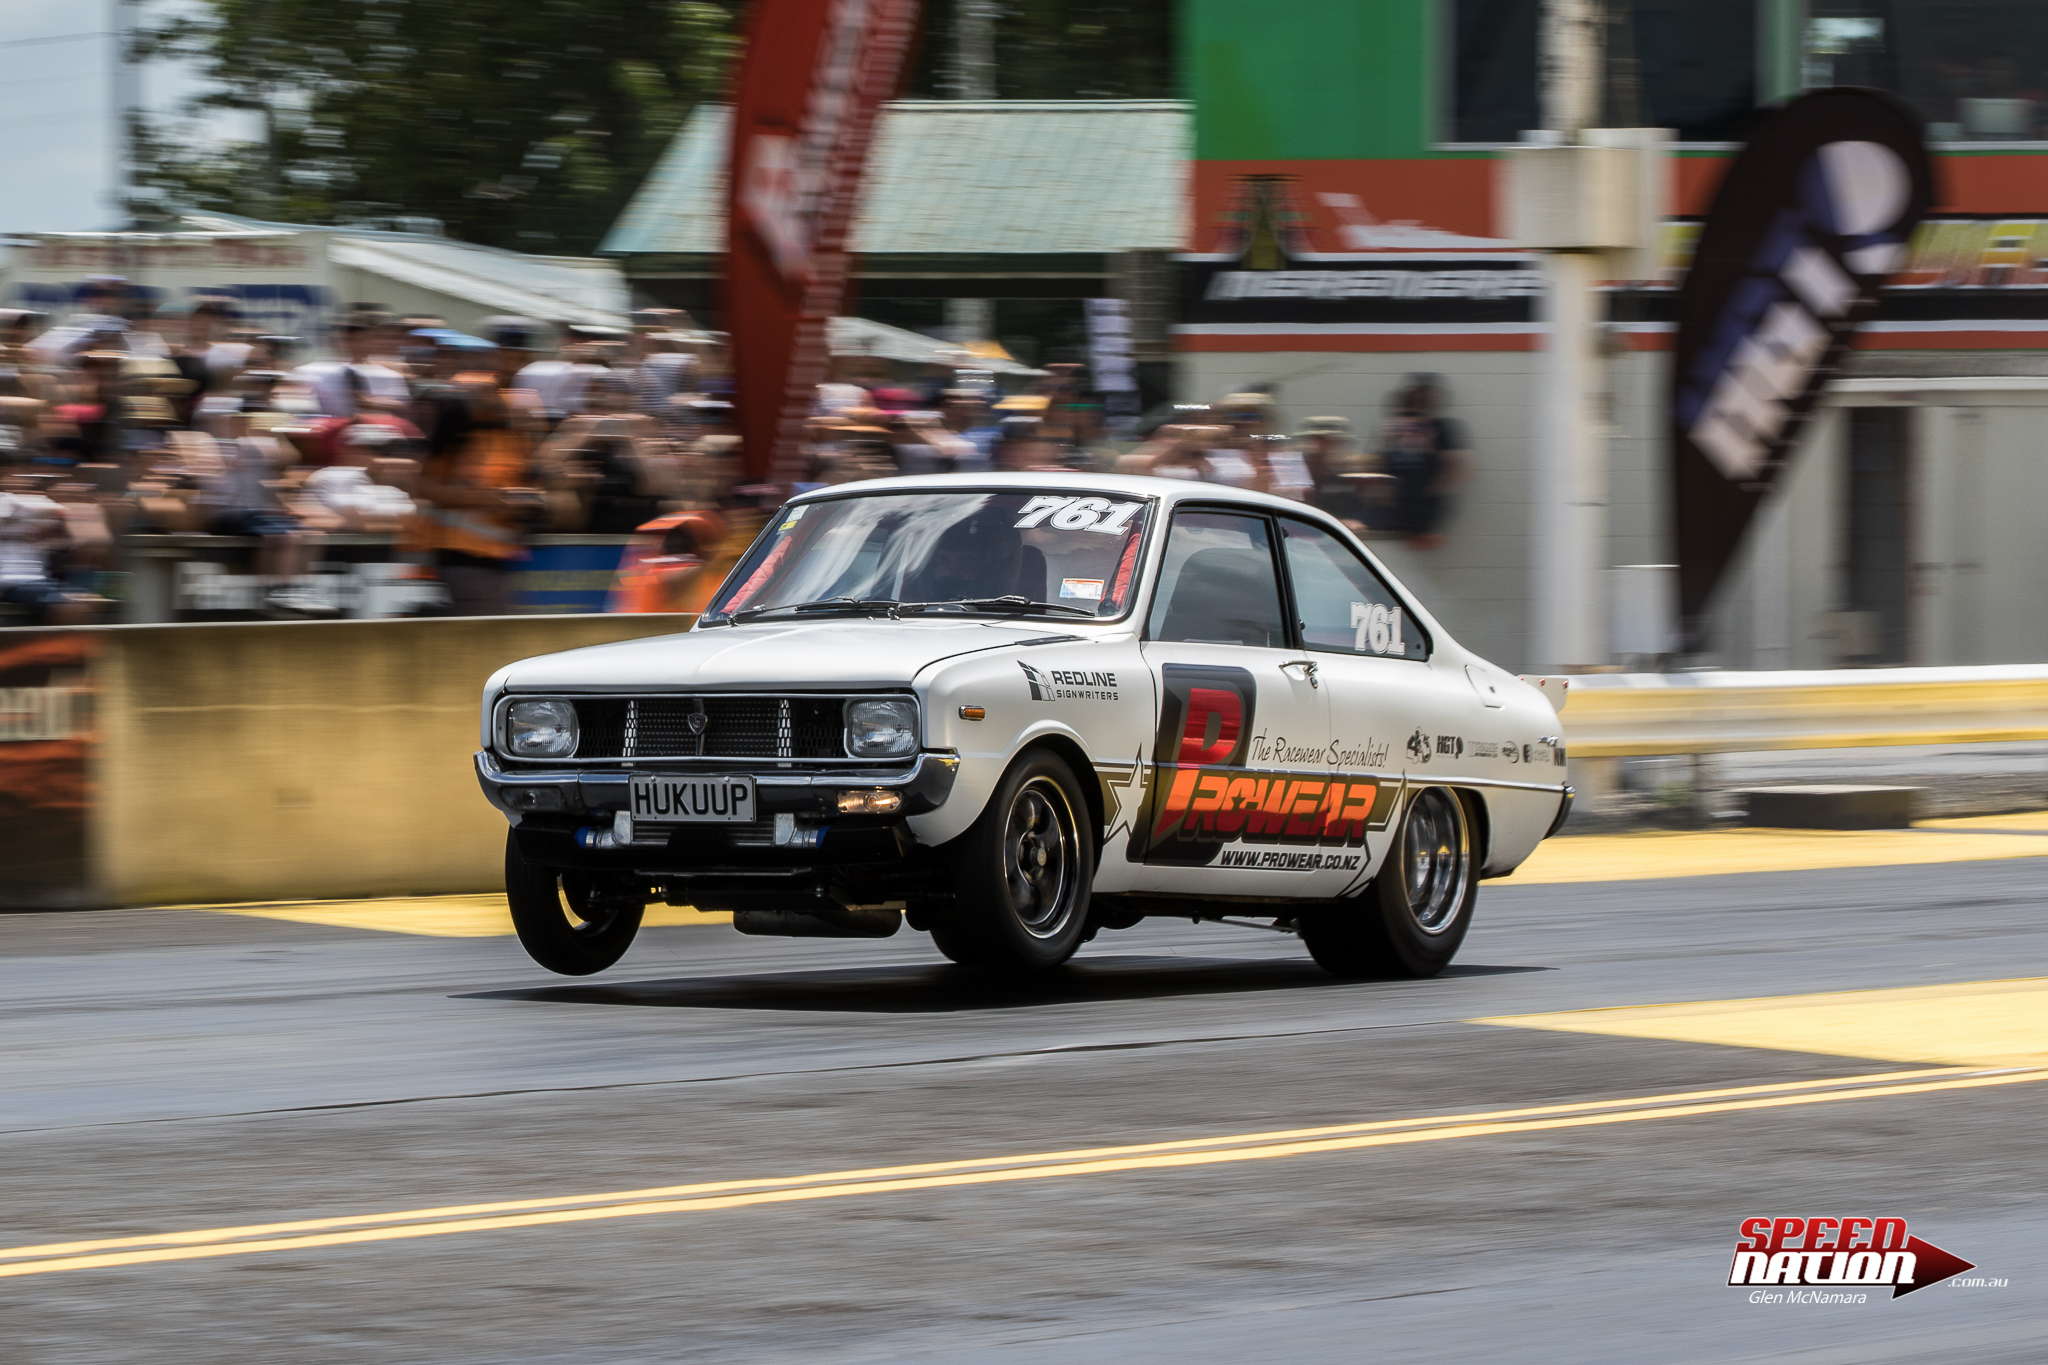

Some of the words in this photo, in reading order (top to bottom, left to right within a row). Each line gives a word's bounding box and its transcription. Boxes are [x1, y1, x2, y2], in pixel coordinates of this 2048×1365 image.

[1013, 495, 1144, 536] 761
[1350, 602, 1405, 656] 761
[1050, 670, 1118, 688] REDLINE
[1056, 689, 1119, 701] SIGNWRITERS
[1153, 688, 1377, 839] PROWEAR
[1251, 727, 1271, 762] The
[1272, 736, 1326, 764] Racewear
[1326, 736, 1390, 774] Specialists!
[633, 782, 748, 815] HUKUUP
[1220, 850, 1361, 871] WWW.PROWEAR.CO.NZ
